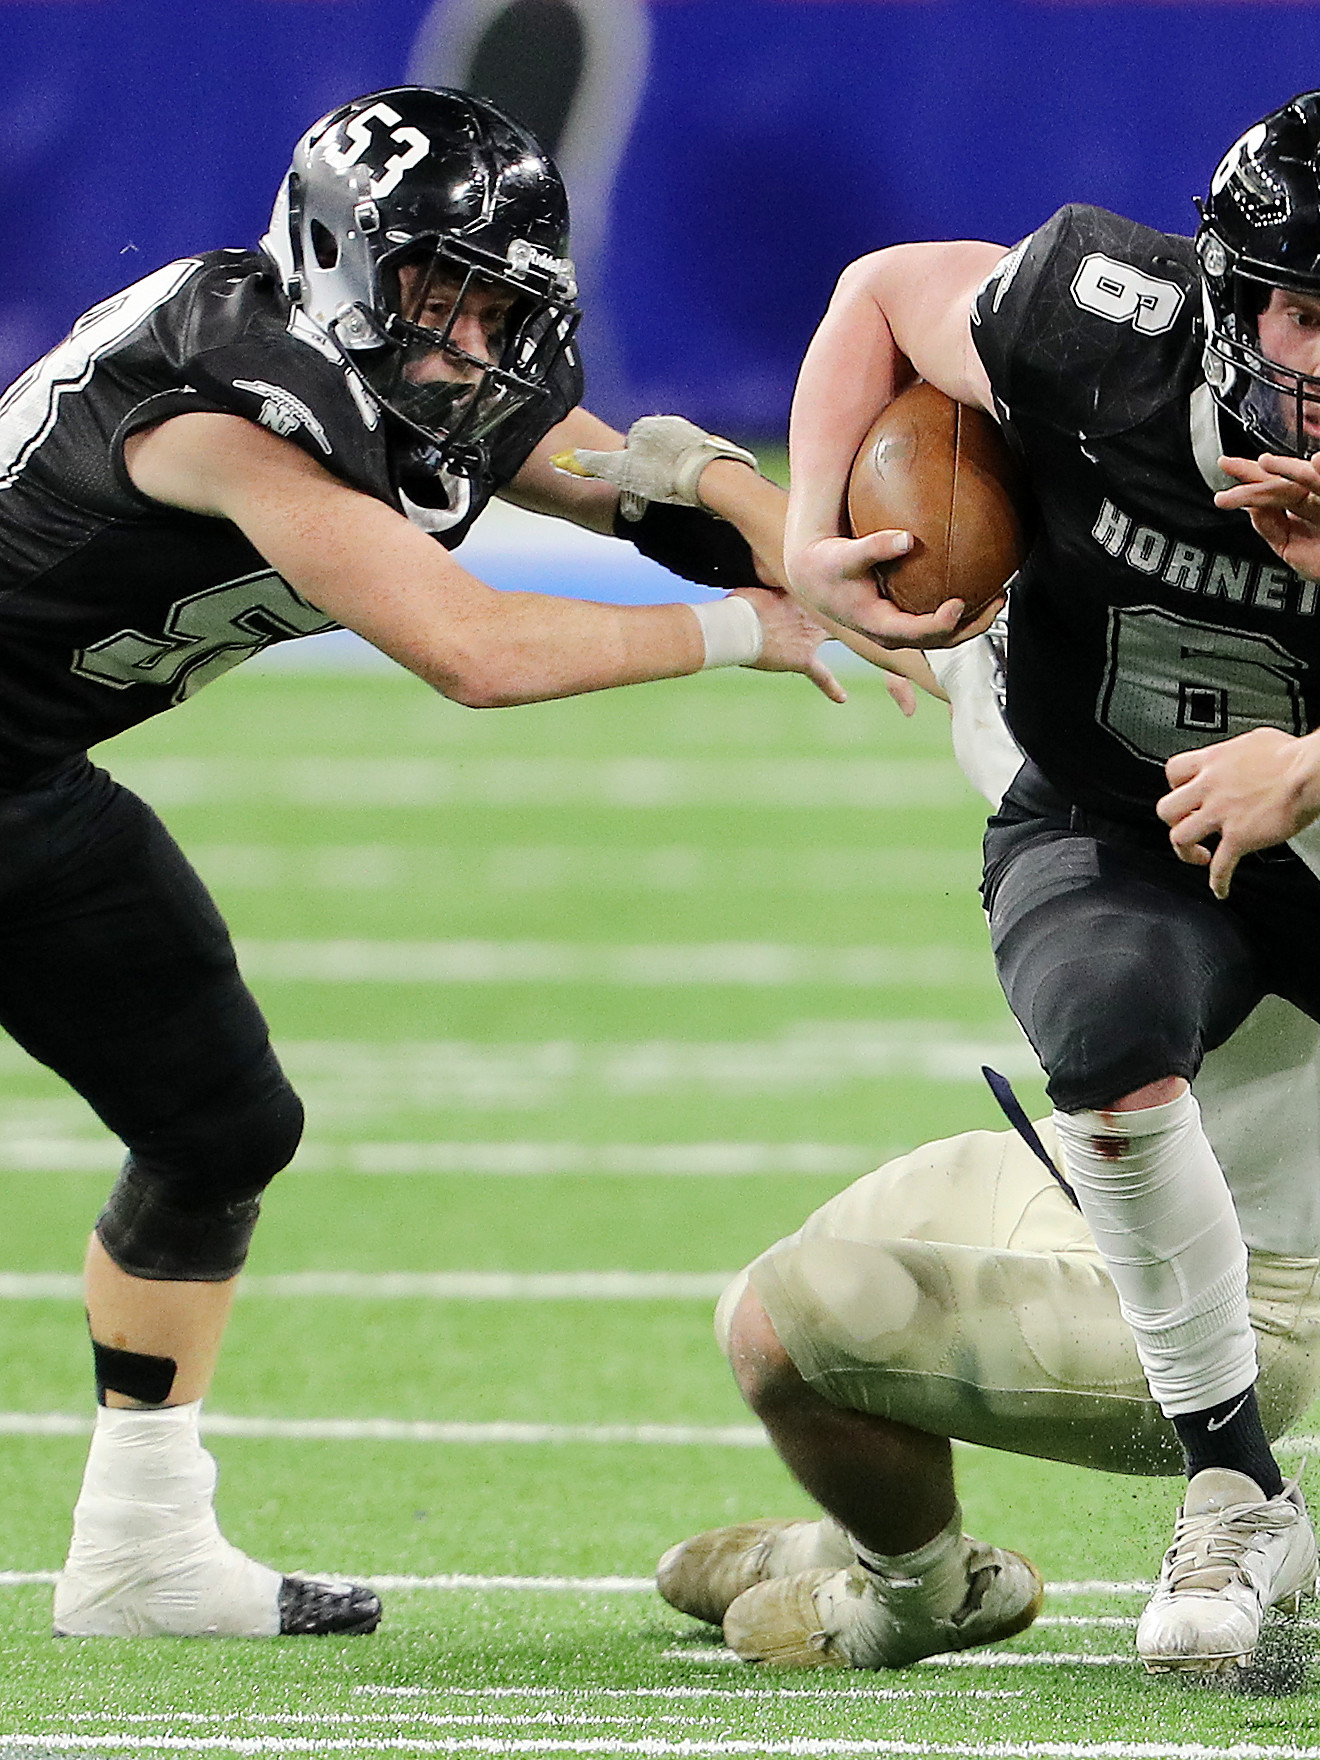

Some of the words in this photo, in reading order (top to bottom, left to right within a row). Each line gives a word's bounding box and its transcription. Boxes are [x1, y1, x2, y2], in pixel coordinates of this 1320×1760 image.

[322, 101, 431, 200] 53
[1070, 252, 1186, 336] 6
[1095, 603, 1310, 767] 6
